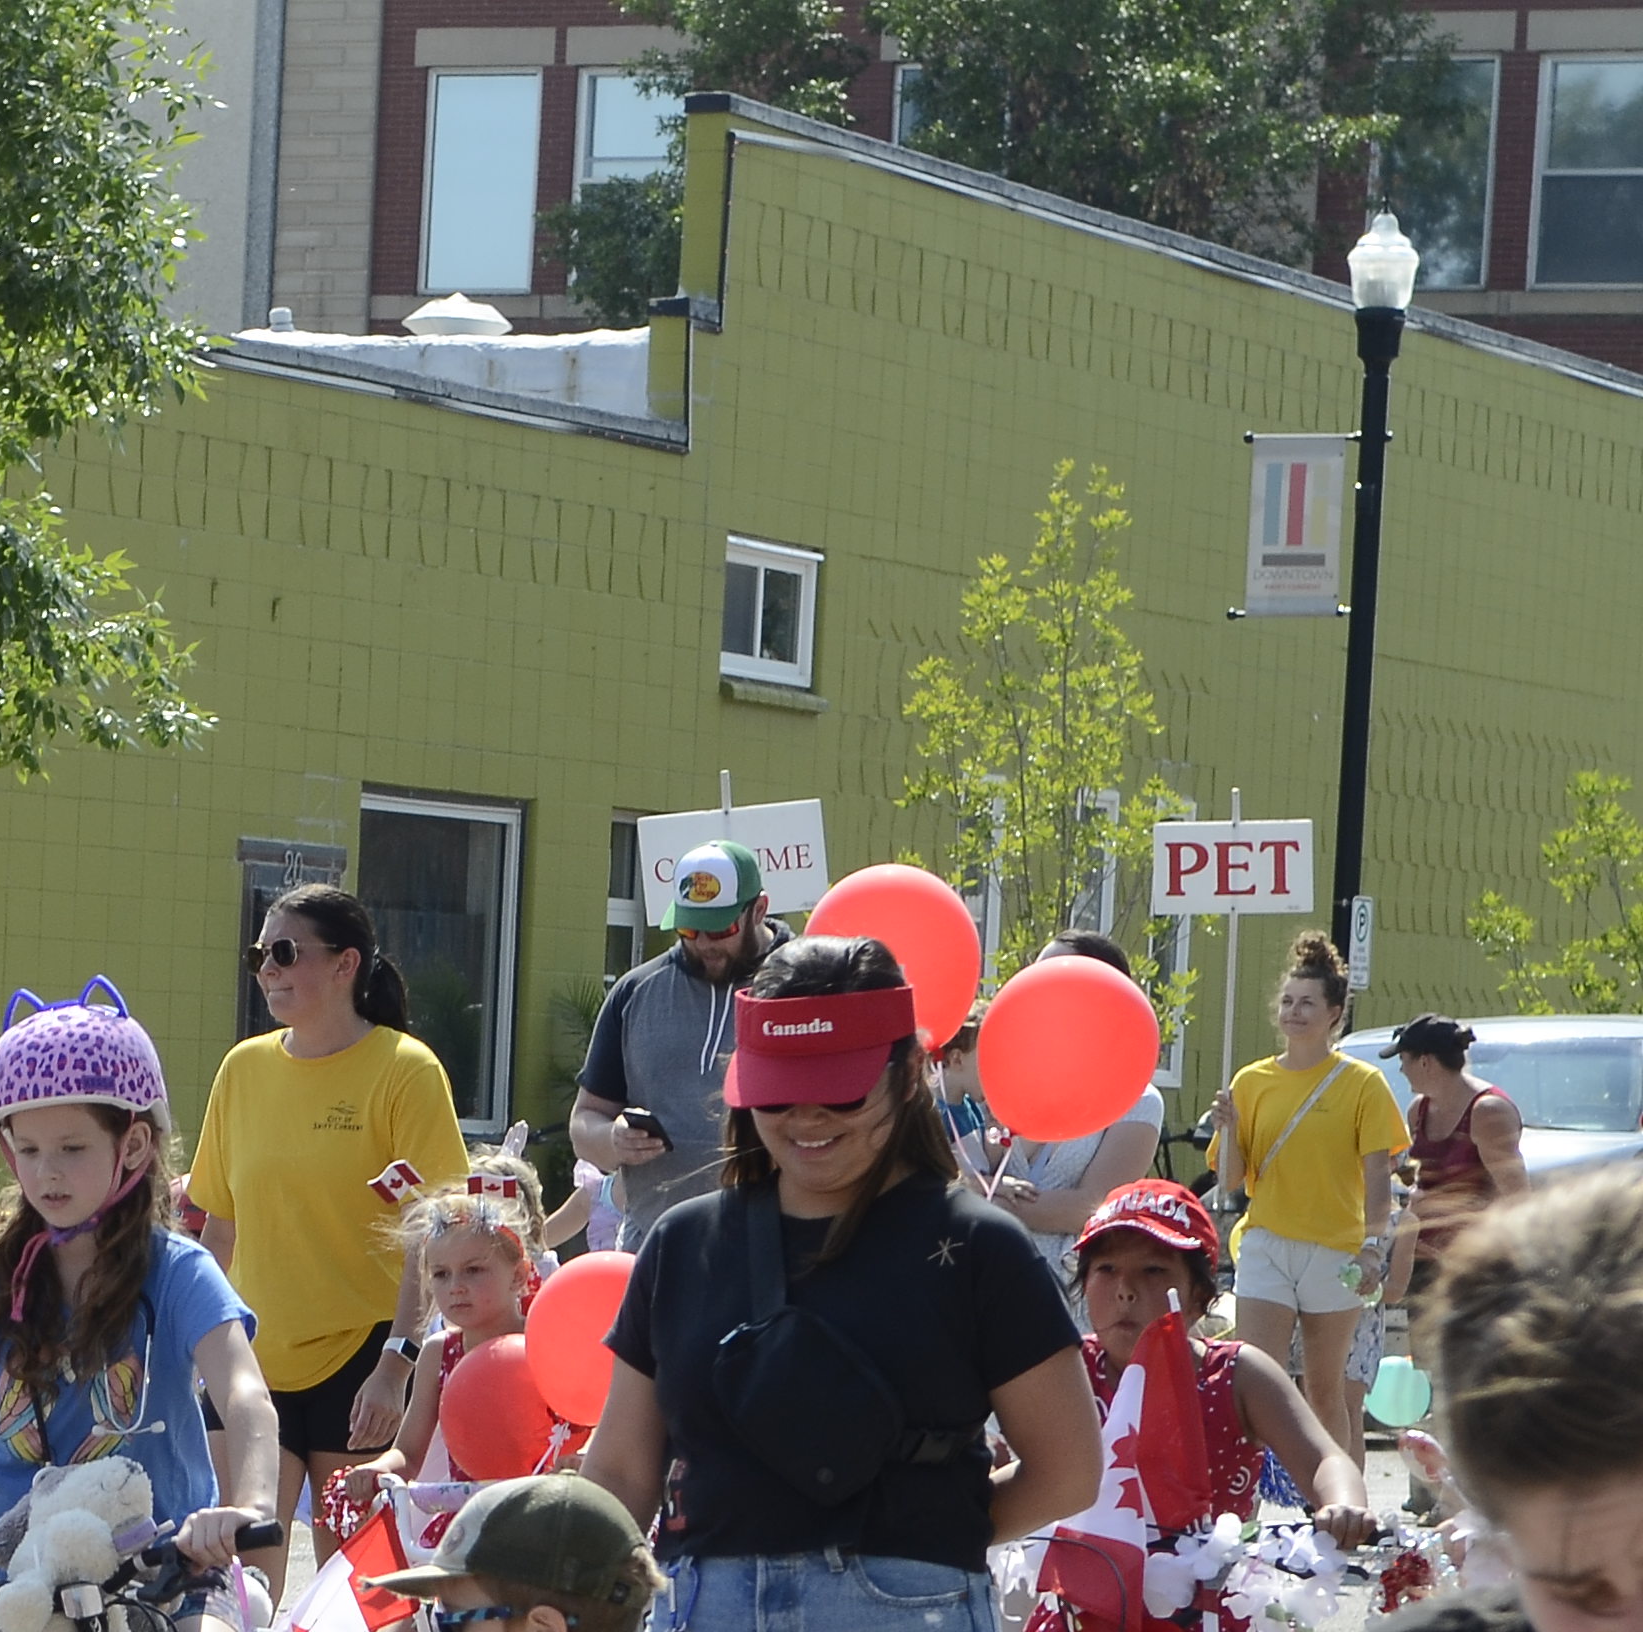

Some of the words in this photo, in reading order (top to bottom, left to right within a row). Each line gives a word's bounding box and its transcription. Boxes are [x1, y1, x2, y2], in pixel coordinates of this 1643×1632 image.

[1253, 569, 1334, 580] DOWNTOWN
[1164, 841, 1300, 896] PET
[762, 1018, 834, 1037] Canada
